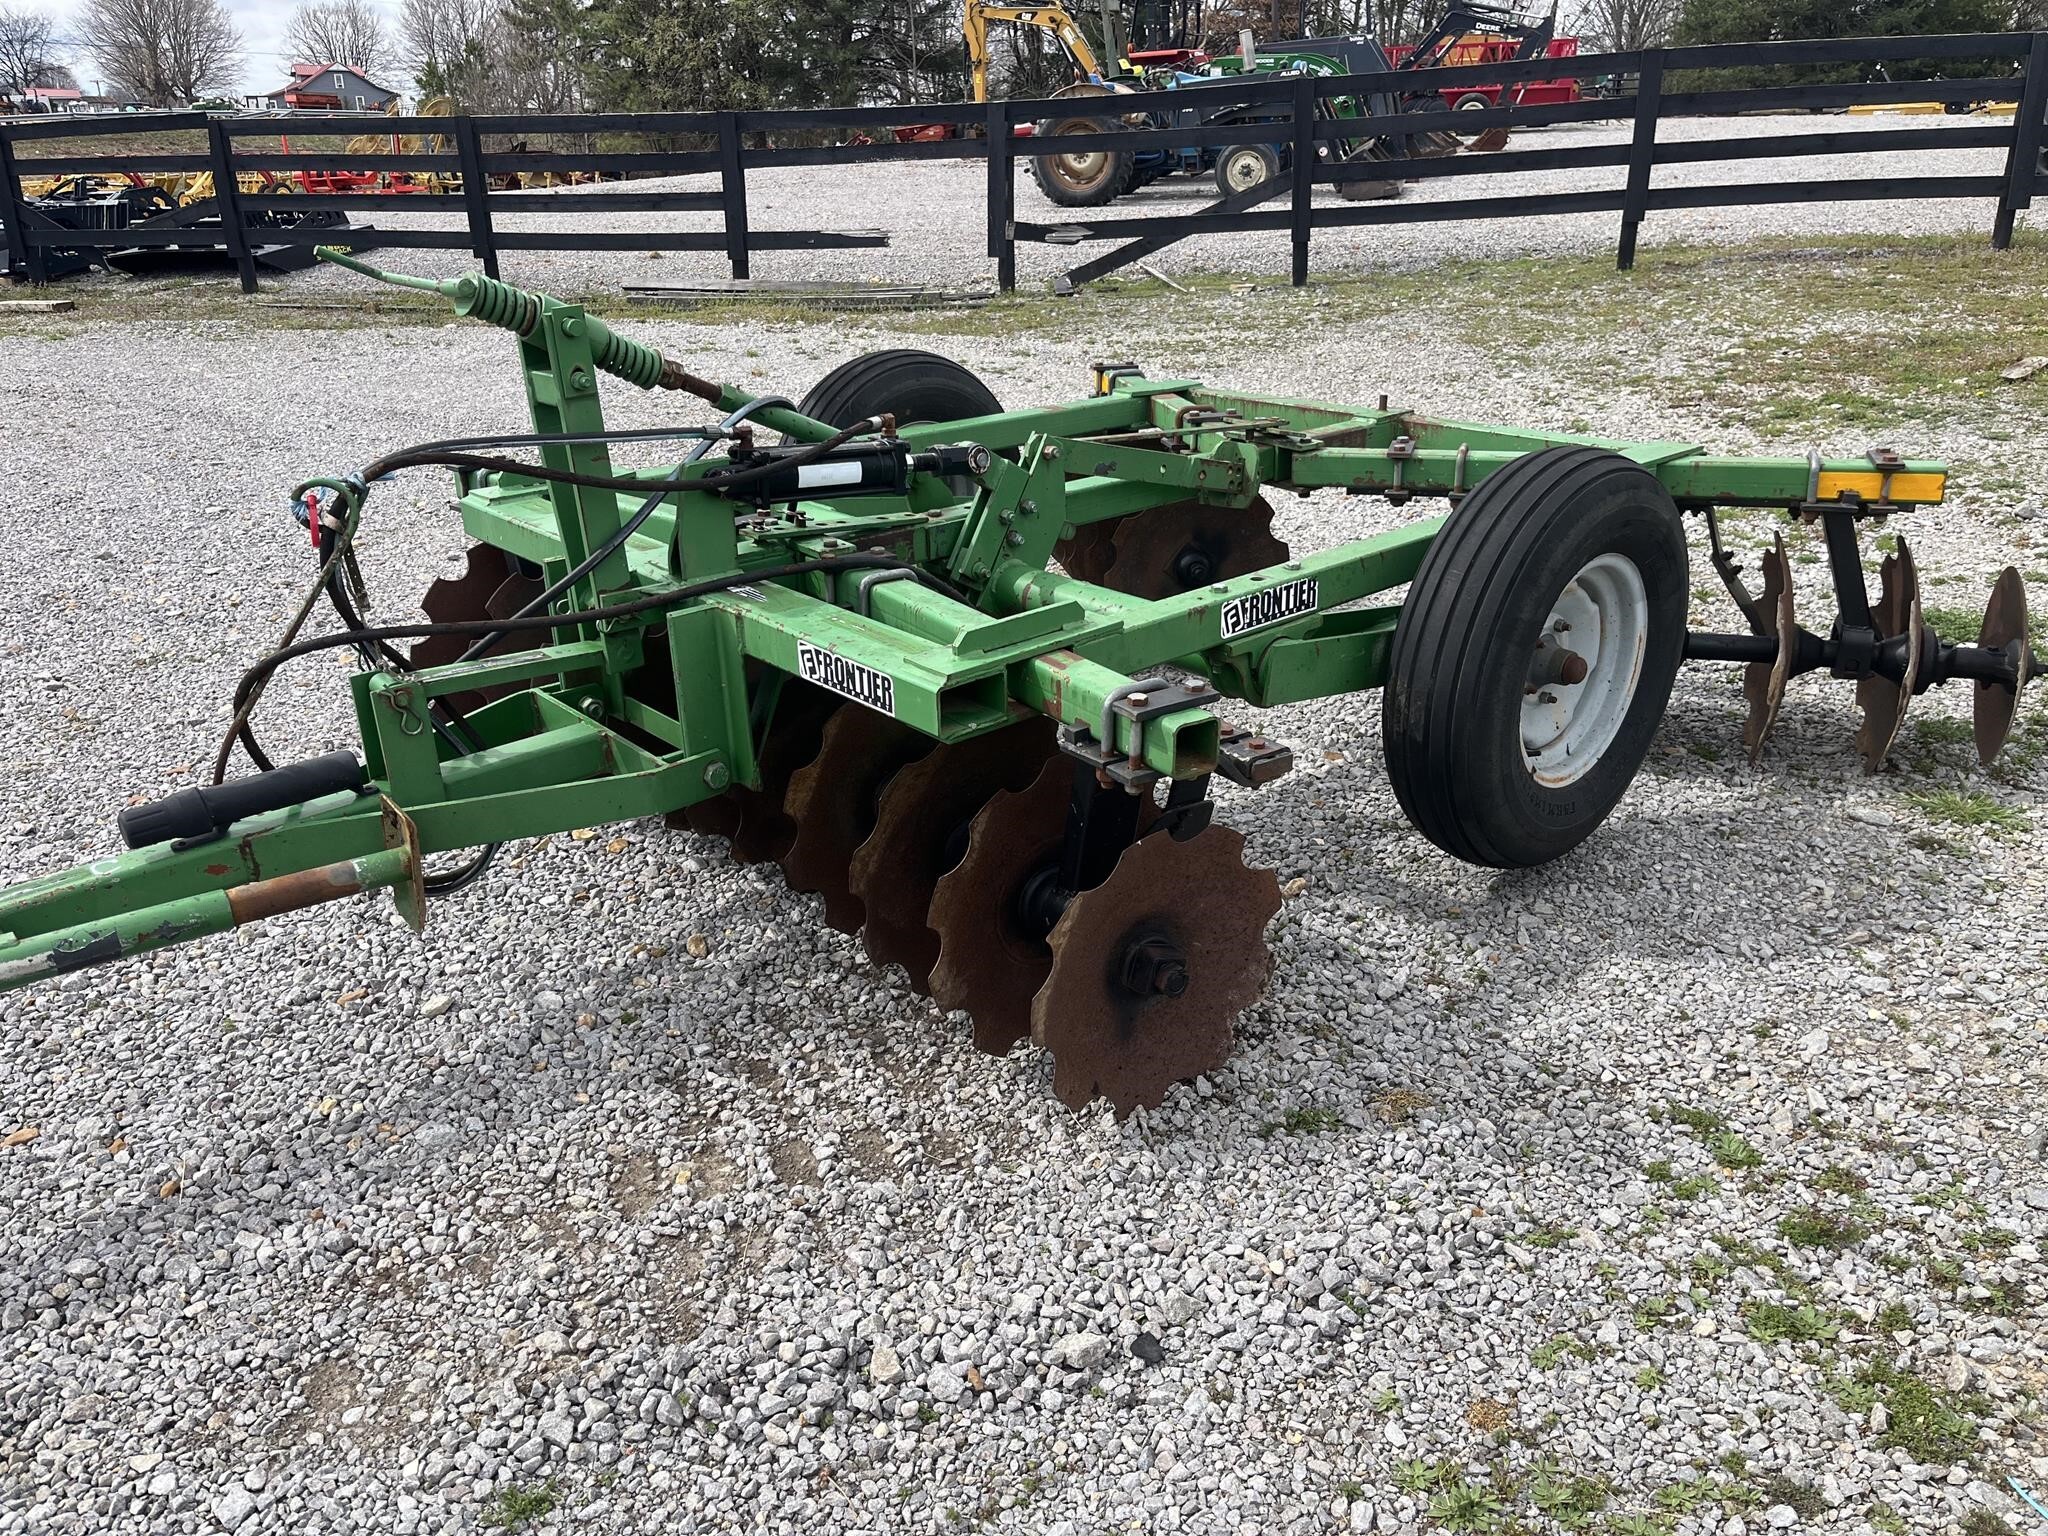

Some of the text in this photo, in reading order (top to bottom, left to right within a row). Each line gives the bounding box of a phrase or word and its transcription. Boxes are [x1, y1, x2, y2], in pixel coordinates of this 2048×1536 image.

[1021, 12, 1033, 21] CAT
[1475, 22, 1501, 32] DEERE
[1240, 578, 1317, 627] FRONTIER
[813, 648, 893, 708] FRONTIER
